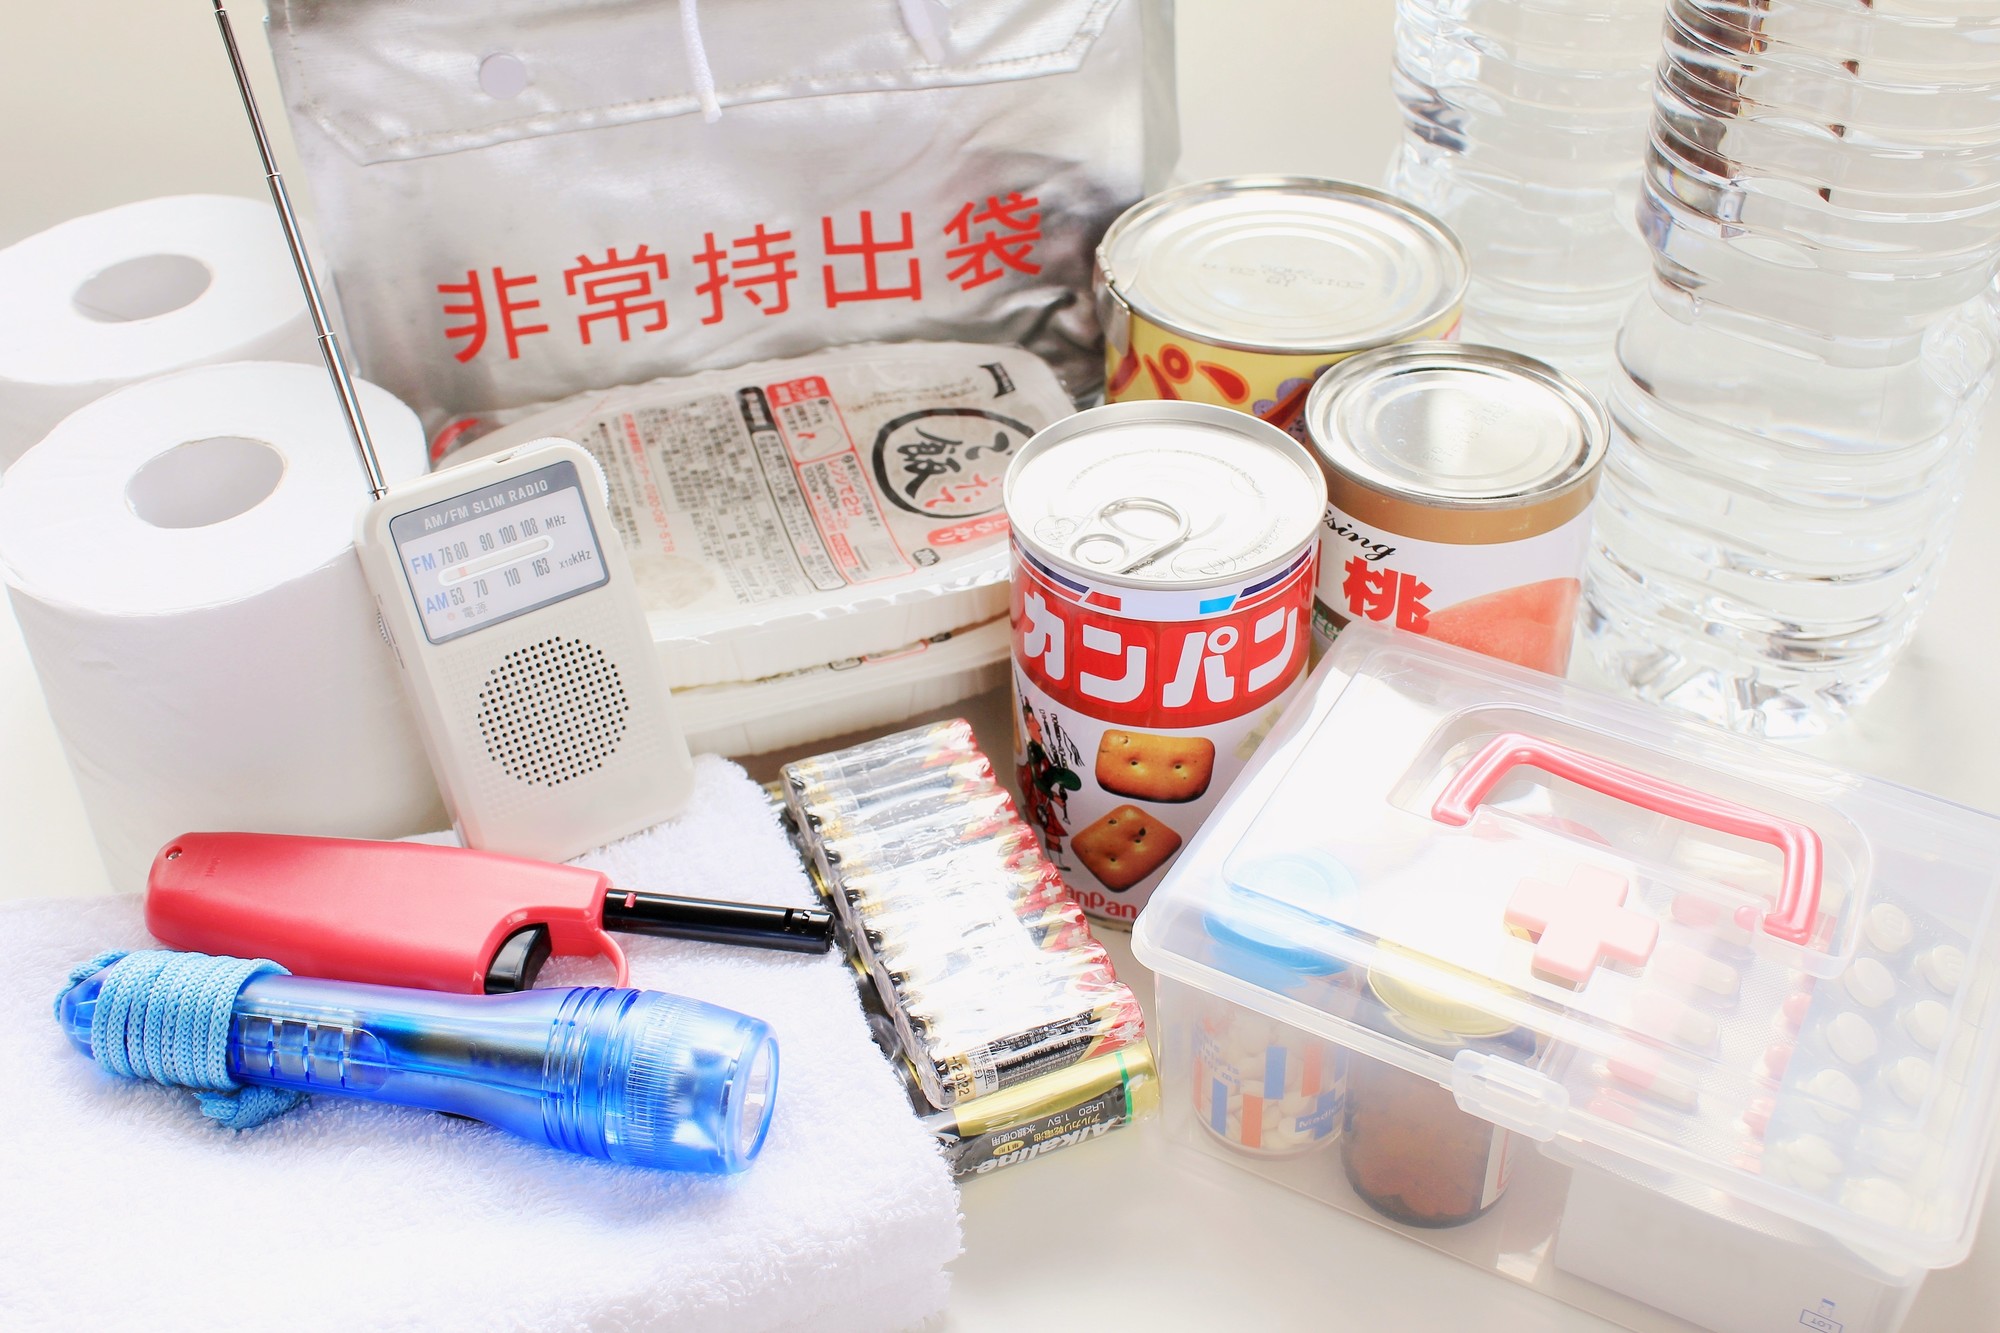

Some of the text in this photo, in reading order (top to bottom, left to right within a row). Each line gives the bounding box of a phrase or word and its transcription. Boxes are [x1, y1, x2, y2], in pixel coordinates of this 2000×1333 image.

[437, 192, 1043, 363] 非常持出袋
[424, 479, 549, 531] AM/FM SLIM RADIO
[411, 514, 568, 575] FM 76 80 90 100 108 MHz
[424, 592, 451, 615] AM
[450, 586, 465, 605] 53
[473, 579, 489, 598] 70
[504, 567, 522, 587] 110
[532, 559, 551, 578] 163
[461, 601, 488, 620] 電源
[1342, 554, 1433, 634] 桃
[1023, 590, 1299, 708] カンパン
[1064, 886, 1138, 918] anPan
[1032, 1111, 1102, 1144] アルカリ乾電池
[1046, 1110, 1070, 1129] 1.5V
[1078, 1099, 1106, 1117] LR20
[976, 1114, 1116, 1175] Alkaline
